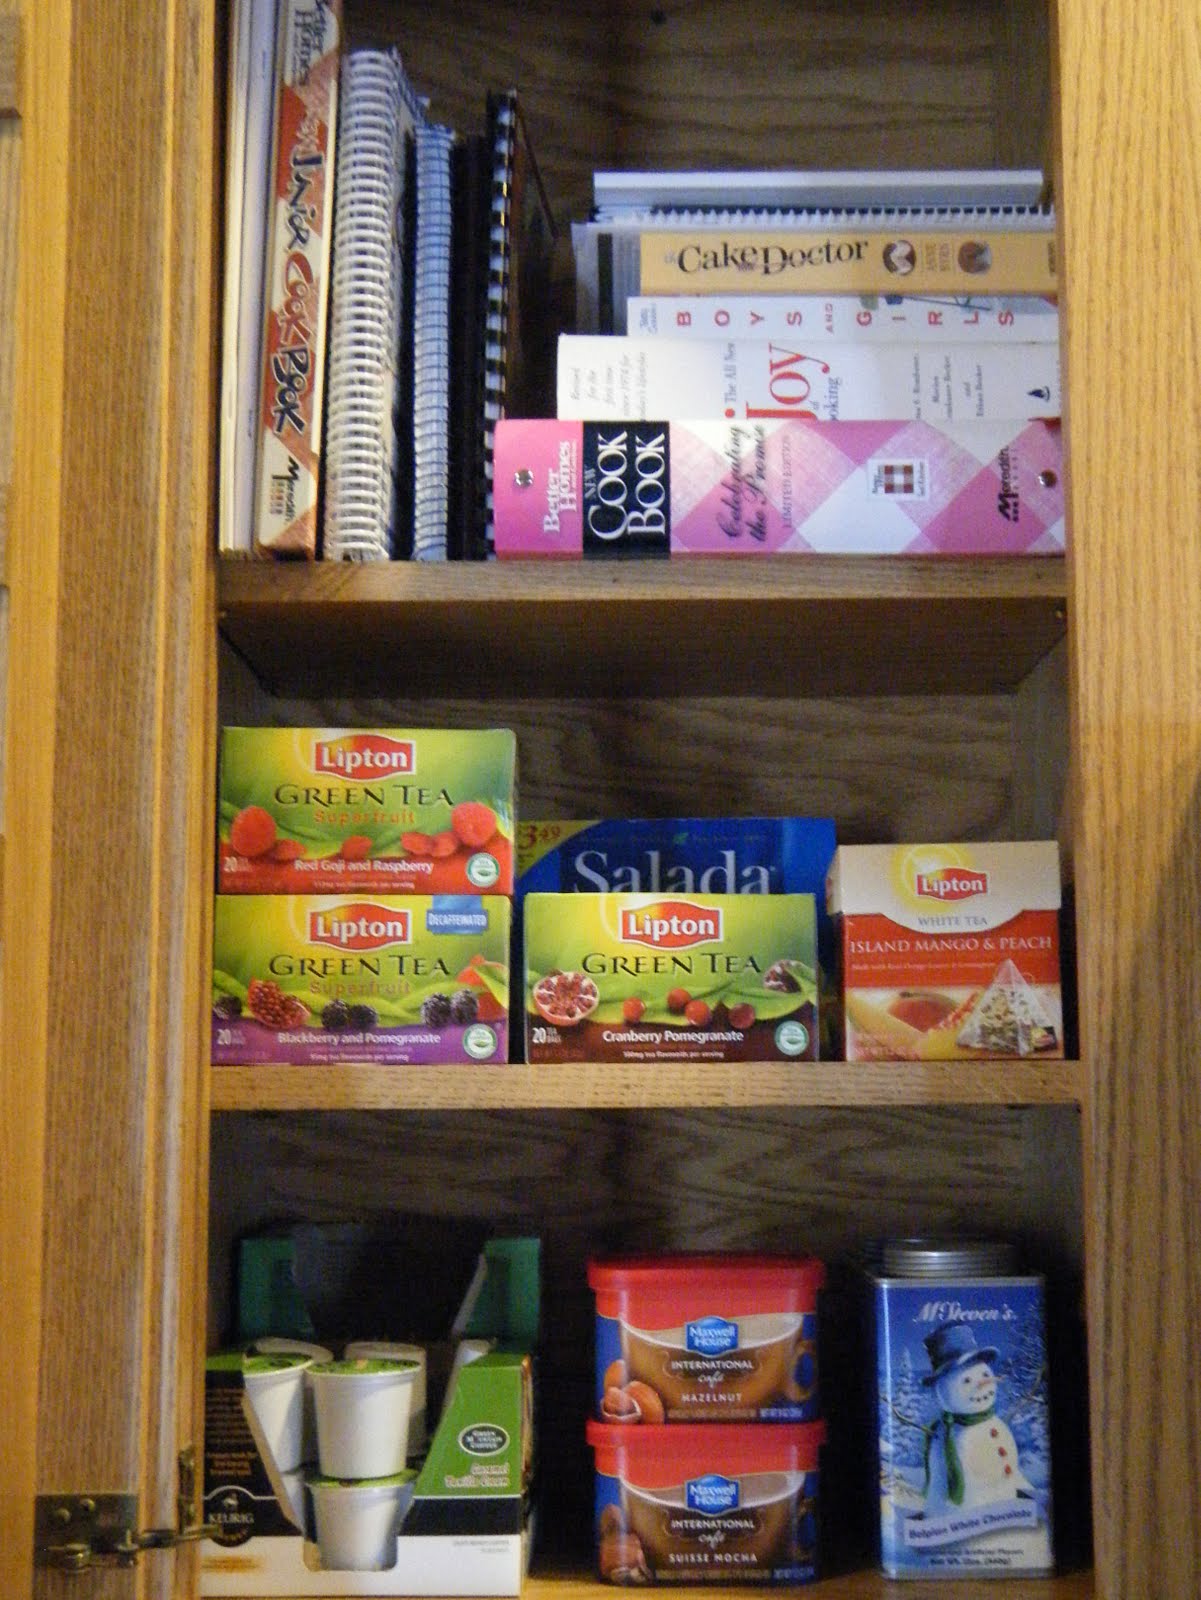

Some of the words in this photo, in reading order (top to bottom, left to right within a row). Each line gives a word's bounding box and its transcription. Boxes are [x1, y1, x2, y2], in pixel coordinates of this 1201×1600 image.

[762, 240, 868, 275] Doctor
[725, 364, 737, 380] All
[746, 343, 830, 420] Joy
[725, 382, 737, 403] The
[744, 425, 768, 506] Promise
[559, 440, 577, 512] Homes
[583, 467, 597, 499] NEW
[716, 426, 750, 538] Celebrating
[998, 445, 1019, 522] Meredith
[544, 468, 561, 533] Better
[782, 479, 793, 529] LIMITED
[744, 510, 768, 542] the
[322, 746, 408, 773] Lipton
[275, 783, 385, 807] GREEN
[392, 783, 454, 806] TEA
[313, 810, 416, 826] Superfruit
[224, 856, 237, 873] 20
[294, 860, 319, 871] Red
[347, 860, 371, 871] and
[372, 860, 434, 875] Raspberry
[573, 850, 771, 893] Salada
[922, 876, 984, 896] Lipton
[317, 917, 403, 944] Lipton
[628, 913, 715, 942] Lipton
[918, 916, 960, 927] WHITE
[965, 916, 988, 927] TEA
[850, 940, 910, 954] ISLAND
[915, 938, 979, 952] MANGO
[983, 938, 995, 951] &
[1000, 936, 1053, 950] PEACH
[269, 954, 380, 979] GREEN
[388, 955, 451, 976] TEA
[582, 952, 693, 978] GREEN
[701, 952, 761, 974] TEA
[309, 980, 412, 997] Superfruit
[217, 1029, 231, 1045] 20
[277, 1032, 339, 1046] Blackberry
[341, 1032, 364, 1043] and
[364, 1033, 442, 1046] Pomegranate
[532, 1027, 546, 1044] 20
[602, 1030, 663, 1045] Cranberry
[664, 1030, 745, 1045] Pomegranate
[689, 1325, 736, 1338] Maxwell
[694, 1336, 732, 1347] House
[671, 1360, 754, 1370] INTERNATIONAL
[681, 1393, 743, 1402] HAZELNUT
[689, 1484, 737, 1497] Maxwell
[694, 1495, 733, 1507] House
[671, 1520, 755, 1530] INTERNATIONAL
[669, 1553, 709, 1563] SUISSE
[714, 1552, 758, 1563] MOCHA
